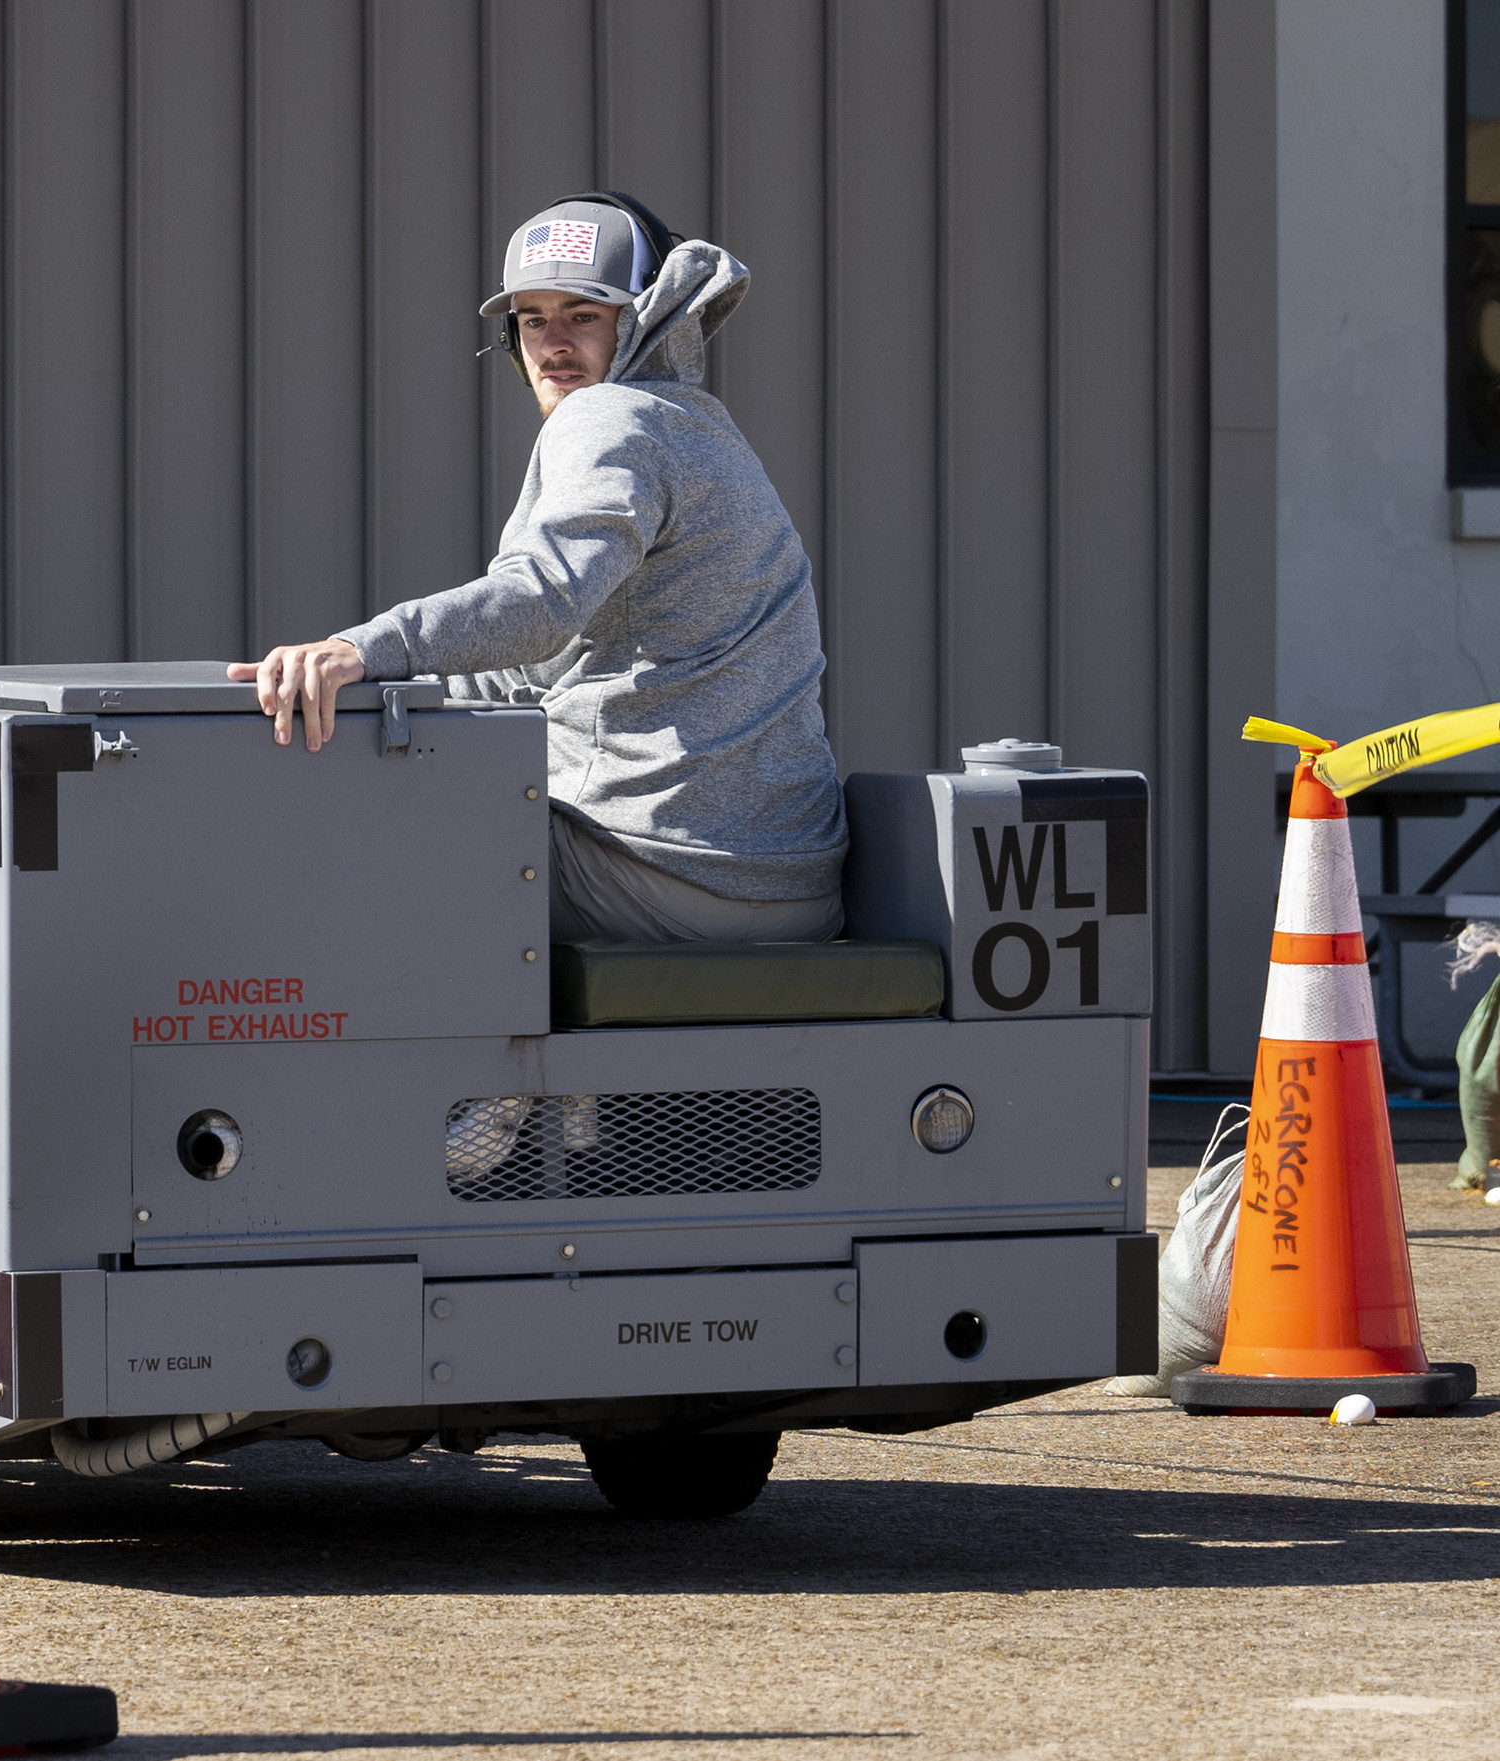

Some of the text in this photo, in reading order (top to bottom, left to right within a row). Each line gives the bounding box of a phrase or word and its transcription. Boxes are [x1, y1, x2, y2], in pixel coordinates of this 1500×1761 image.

[1366, 726, 1421, 776] CAUTION
[971, 823, 1096, 912] WL
[178, 977, 304, 1006] DANGER
[132, 1012, 349, 1042] HOT EXHAUST
[618, 1319, 759, 1345] DRIVE TOW
[128, 1355, 212, 1374] T/W EGLIN
